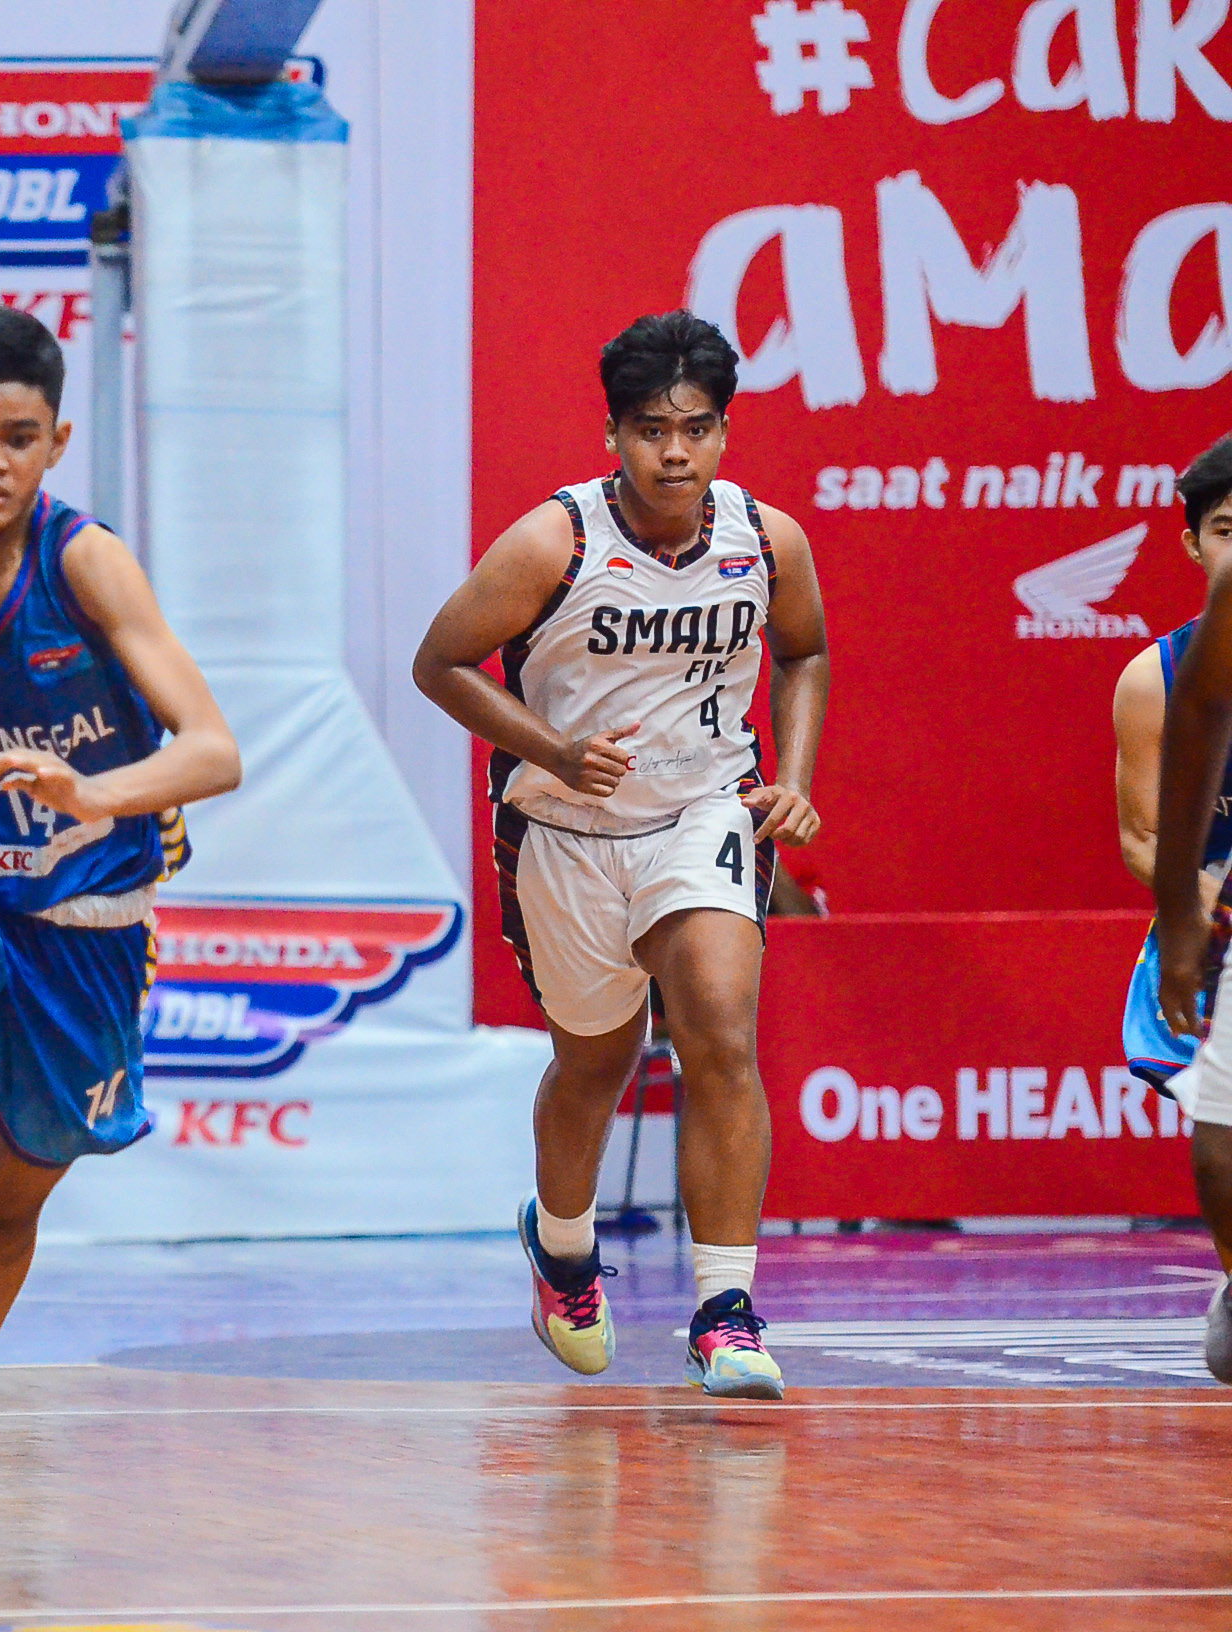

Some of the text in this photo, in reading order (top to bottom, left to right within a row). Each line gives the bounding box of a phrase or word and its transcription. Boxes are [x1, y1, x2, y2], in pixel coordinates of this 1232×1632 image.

[814, 452, 1188, 511] saat naik m
[700, 684, 722, 739] 4
[715, 832, 744, 885] 4
[153, 934, 368, 969] HONDA
[153, 992, 258, 1040] DBL
[171, 1100, 313, 1148] KFC
[799, 1066, 944, 1143] One
